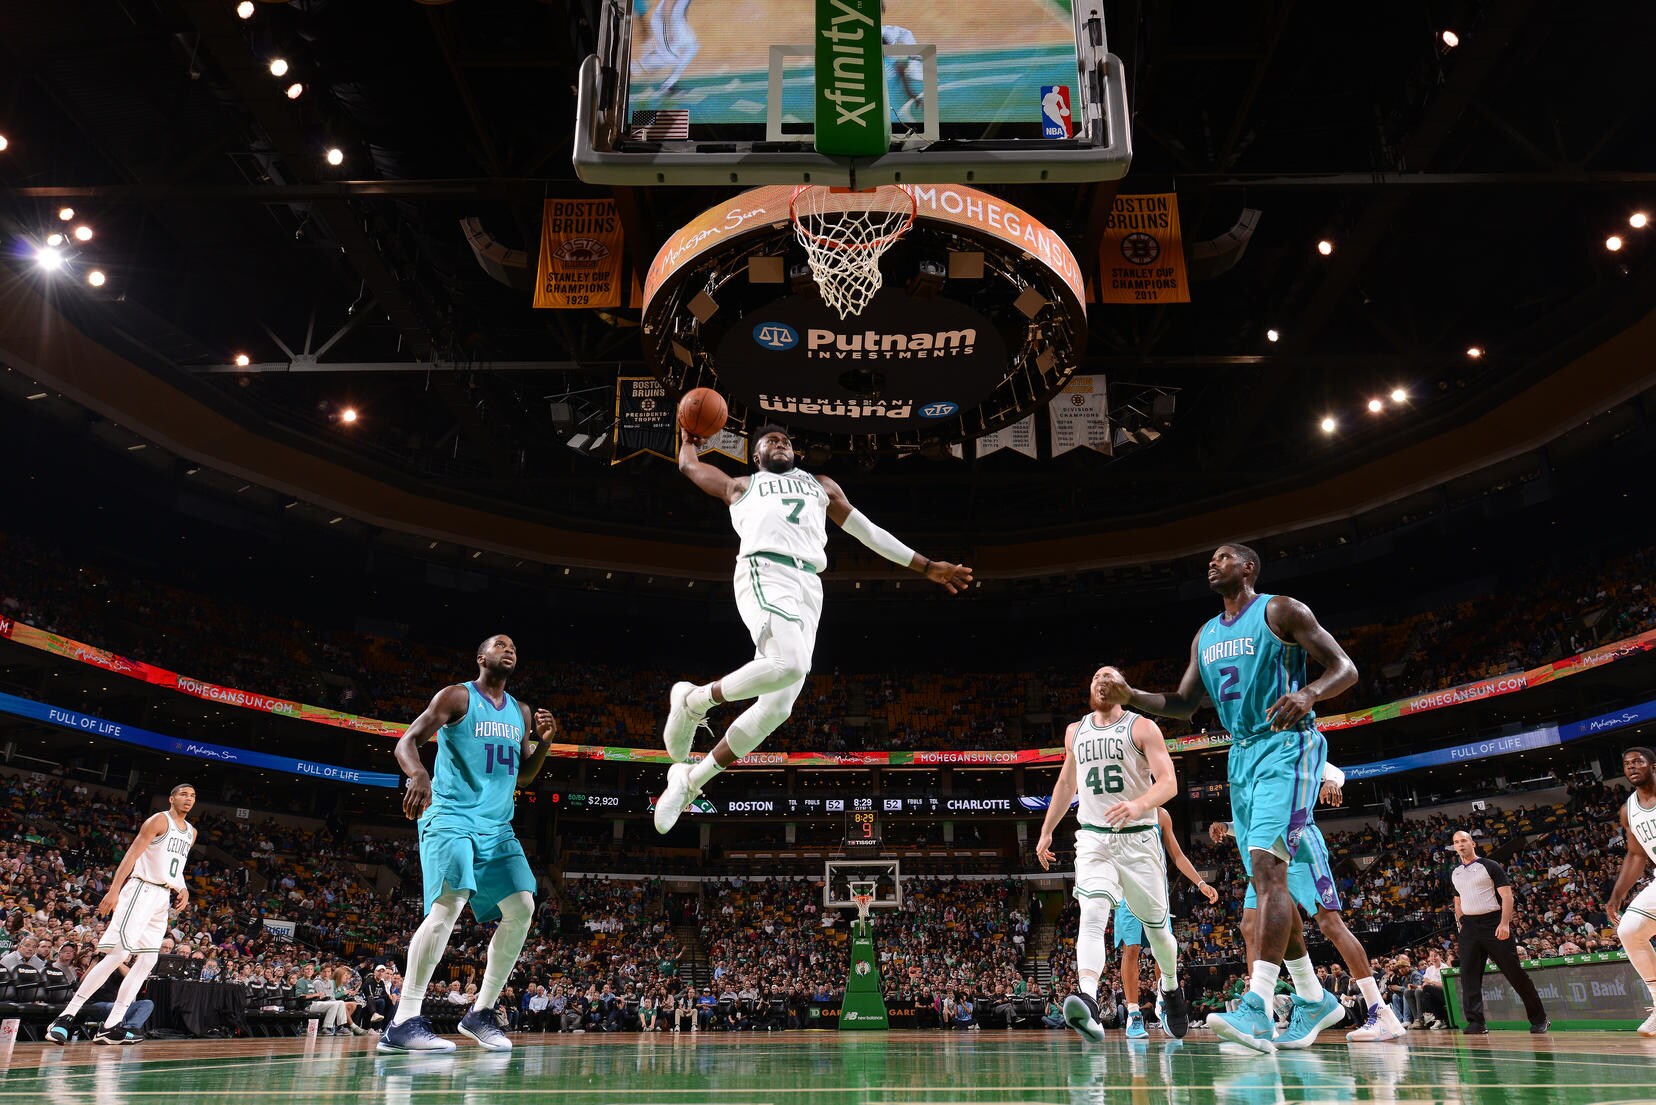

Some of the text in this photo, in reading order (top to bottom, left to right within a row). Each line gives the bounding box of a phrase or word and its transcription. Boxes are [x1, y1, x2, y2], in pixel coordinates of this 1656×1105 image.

[821, 0, 876, 128] xfinity
[1045, 127, 1064, 136] NBA
[554, 202, 617, 218] BOSTON
[1111, 197, 1168, 213] OSTON
[551, 217, 616, 234] BRUINS
[1106, 212, 1169, 229] BRUINS
[661, 208, 767, 273] Mohegan Sun
[547, 271, 611, 283] STANLEY CUP
[1111, 267, 1175, 278] STANLEY CUP
[545, 282, 610, 294] CHAMPIONS
[1112, 279, 1177, 289] CHAMPIONS
[565, 295, 589, 305] 1929
[1135, 290, 1157, 300] 2011
[807, 328, 977, 352] Putnam
[807, 346, 974, 360] INVESTMENTS
[632, 389, 665, 398] BRUINS
[759, 399, 913, 419] Putnam
[758, 478, 819, 498] CELTICS
[781, 498, 806, 525] 7
[1202, 637, 1255, 667] HORNETS
[1218, 665, 1242, 702] 2
[177, 679, 293, 714] MOHEGANSUN.COM
[1410, 676, 1528, 712] MOHEGANSUN.COM
[49, 709, 122, 737] FULL OF LIFE
[1622, 713, 1639, 722] Sun
[475, 721, 521, 743] HORNETS
[1078, 738, 1124, 764] CELTICS
[1450, 737, 1522, 759] FULL OF LIFE
[484, 743, 515, 776] 14
[921, 753, 1018, 762] MOHEGANSUN.COM
[297, 762, 359, 781] FULL OF LIFE
[1085, 764, 1125, 795] 46
[552, 793, 560, 803] 9
[588, 795, 619, 807] $2,920
[728, 801, 773, 811] BOSTON
[828, 798, 898, 809] 52 8:29 52
[947, 799, 1010, 810] CHARLOTTE
[854, 813, 874, 823] 8:29
[862, 822, 872, 838] 9
[1636, 818, 1656, 843] CELT
[167, 837, 190, 859] CELTICS
[169, 857, 179, 878] 0
[1567, 982, 1587, 1003] TD
[1590, 980, 1627, 997] Bank
[821, 1008, 841, 1017] GAR
[888, 1008, 916, 1016] GARD
